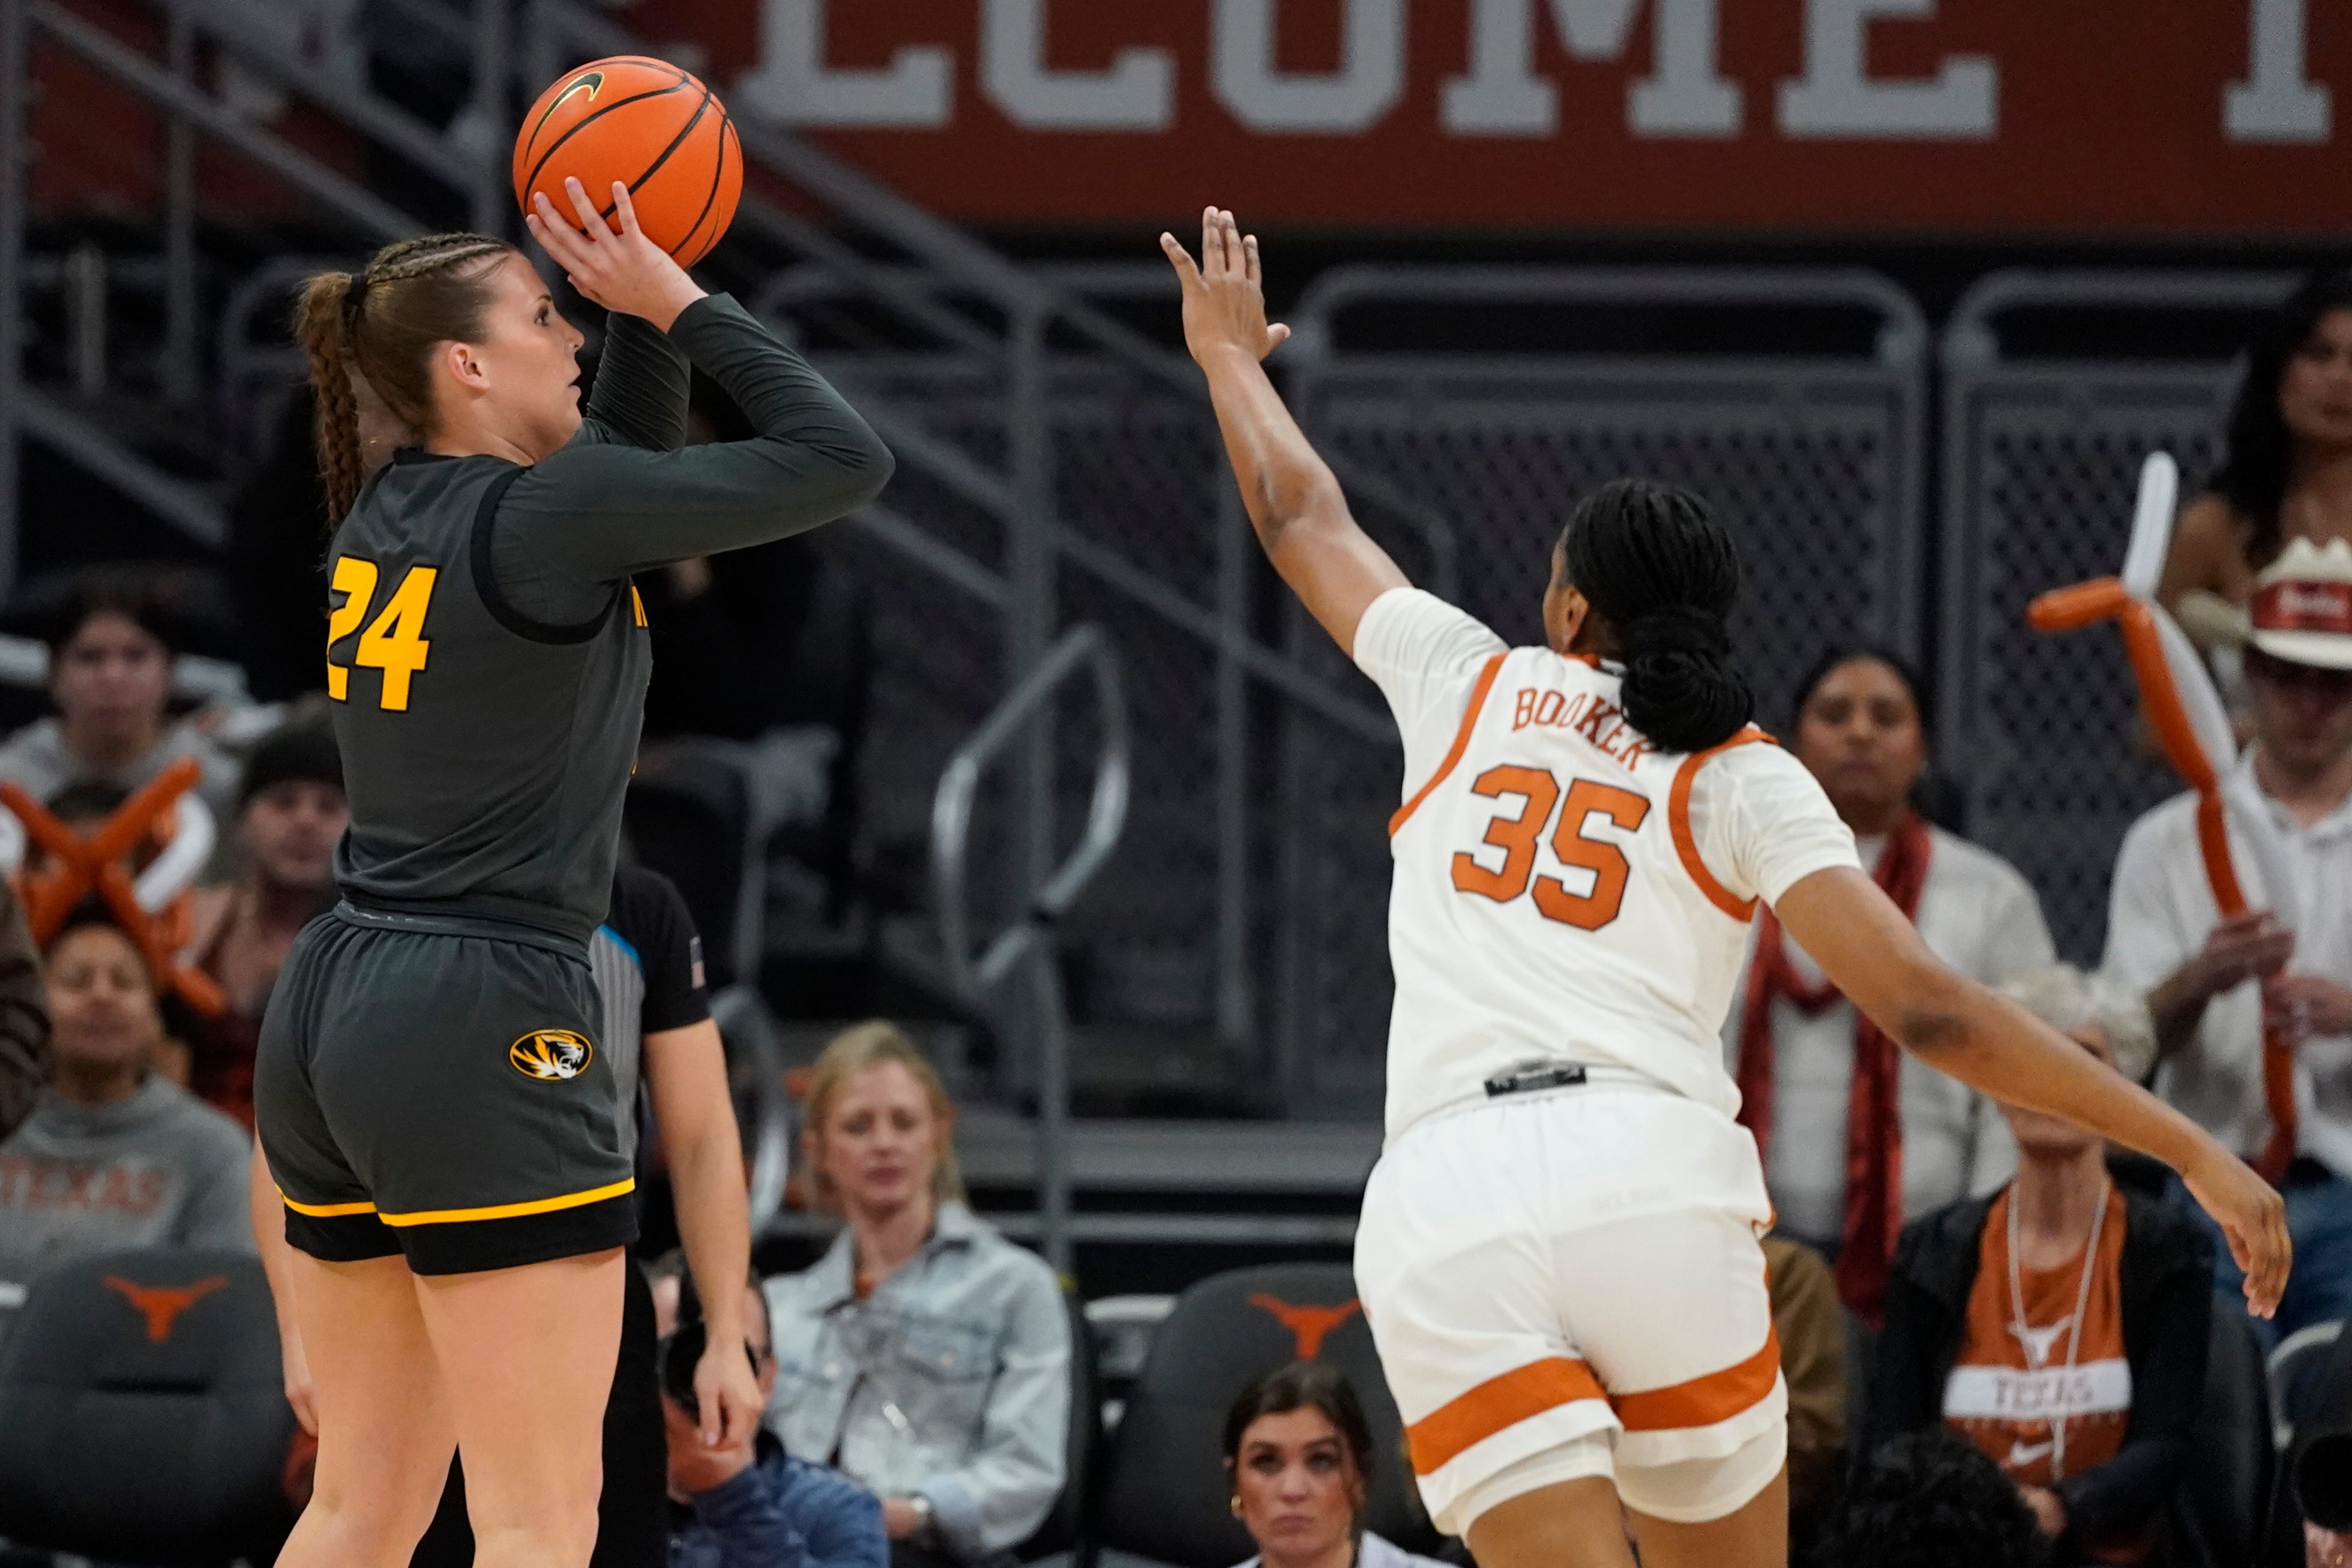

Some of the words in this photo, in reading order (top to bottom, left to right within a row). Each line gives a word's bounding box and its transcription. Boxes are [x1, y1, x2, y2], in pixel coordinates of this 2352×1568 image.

[327, 553, 439, 712] 24
[1512, 686, 1658, 771] BOOKER
[1451, 762, 1651, 933] 35
